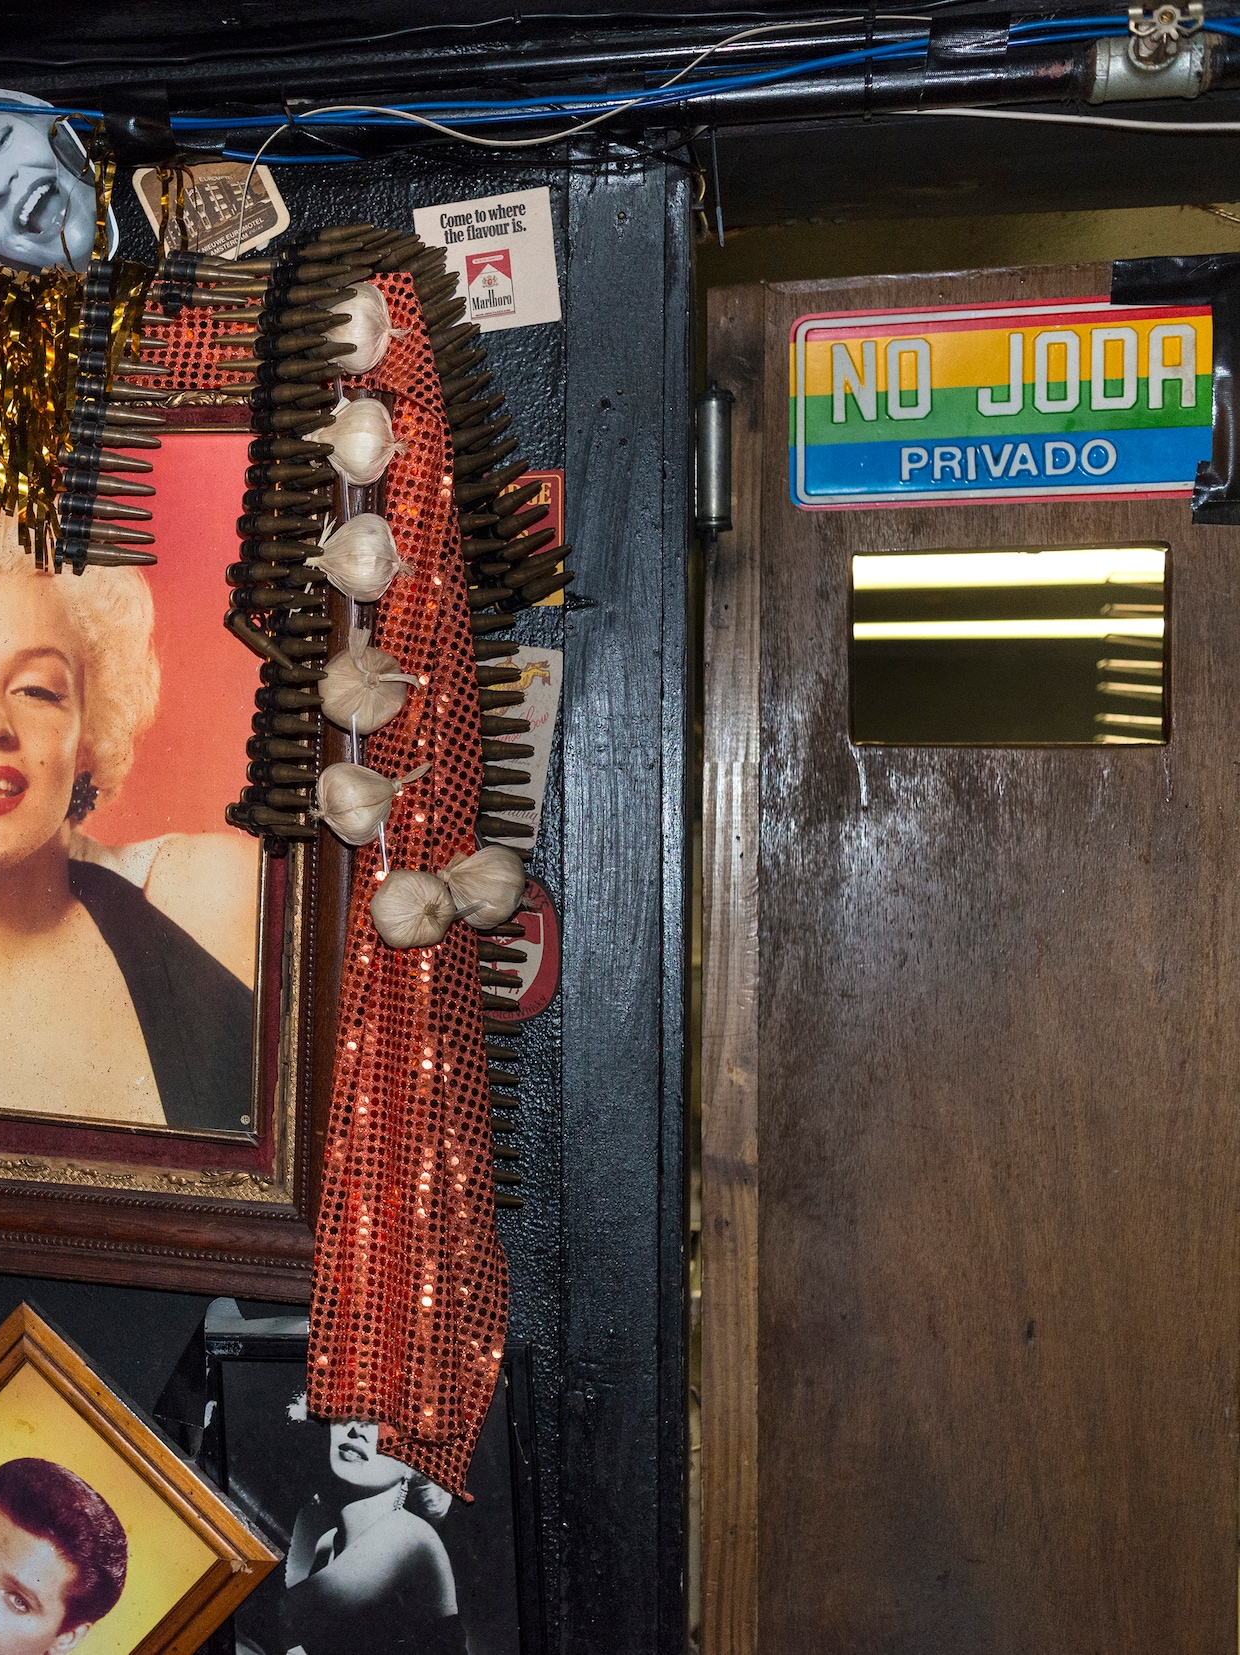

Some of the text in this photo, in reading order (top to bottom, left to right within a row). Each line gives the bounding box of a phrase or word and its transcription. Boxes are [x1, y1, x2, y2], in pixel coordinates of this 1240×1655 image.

[440, 203, 527, 229] Come to where
[444, 218, 527, 244] the flavour is.
[201, 237, 226, 254] NIEUWE
[472, 289, 512, 311] Marlboro
[831, 323, 1198, 424] NO JODA
[899, 438, 1118, 484] PRIVADO
[516, 993, 548, 1018] Whisky
